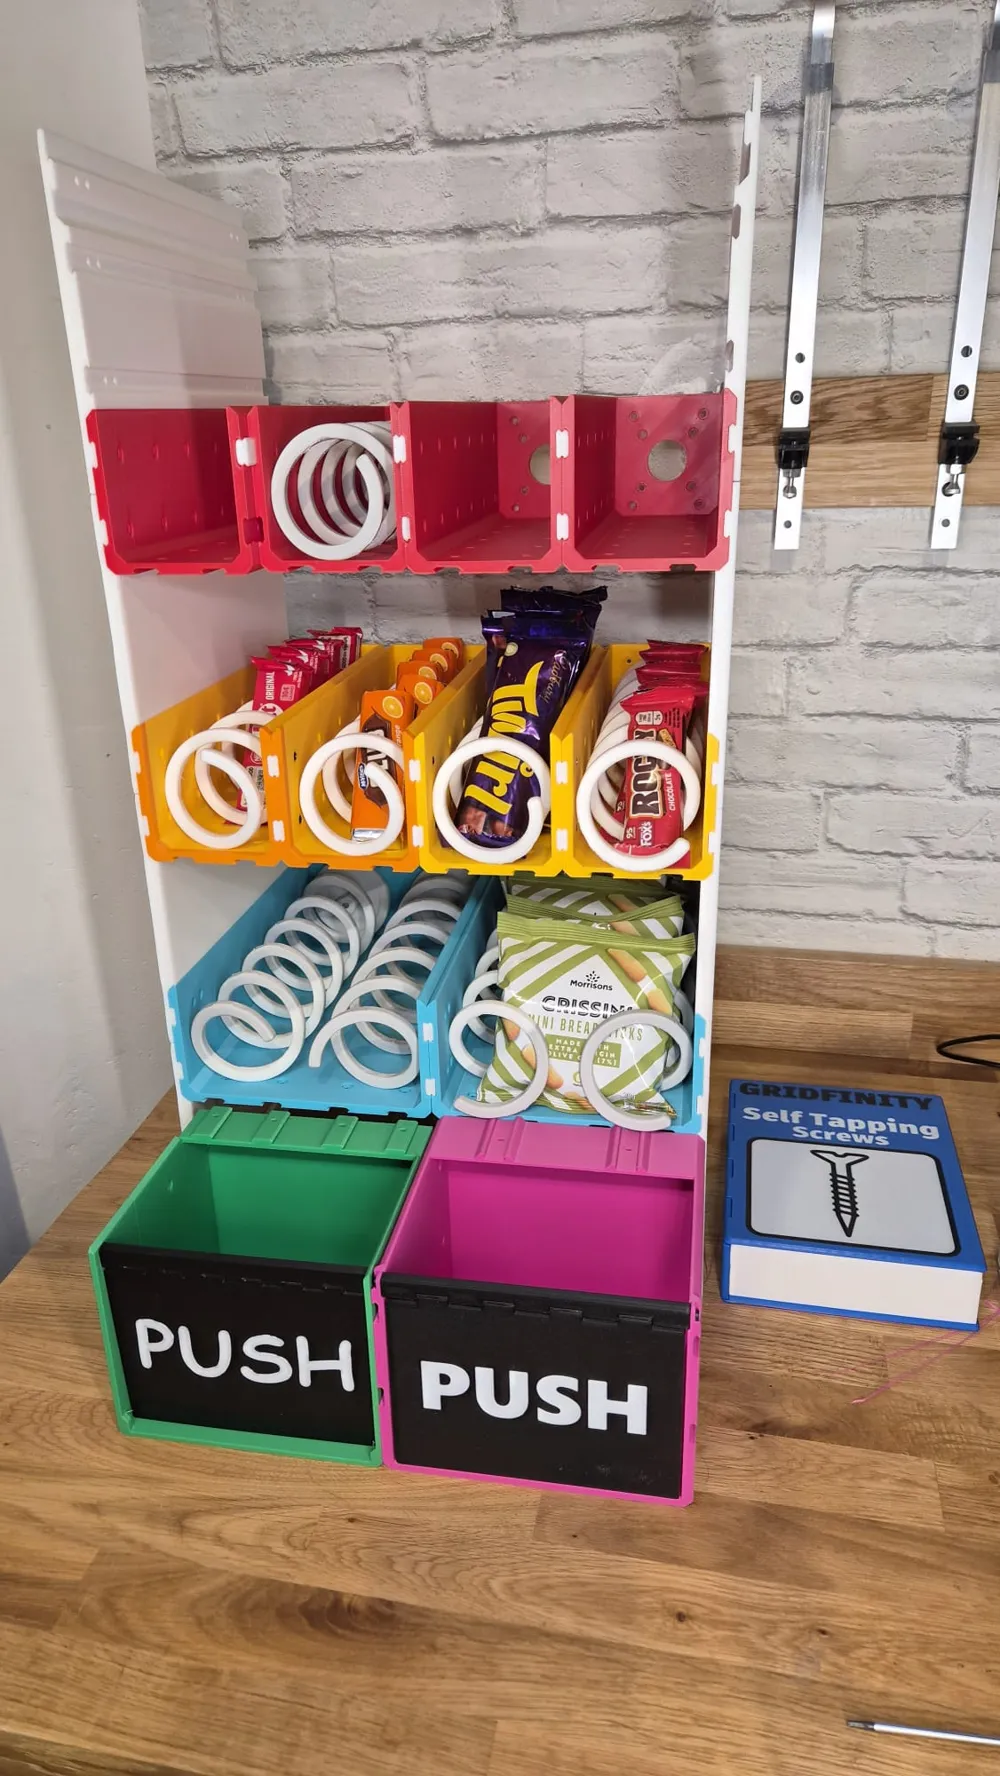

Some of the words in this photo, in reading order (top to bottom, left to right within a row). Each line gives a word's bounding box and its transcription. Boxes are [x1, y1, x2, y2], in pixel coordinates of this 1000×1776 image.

[265, 671, 276, 701] ORIGINAL
[540, 650, 567, 703] Cadbury
[464, 660, 544, 815] Twirl
[630, 729, 661, 816] ROCY
[664, 772, 676, 811] CHOCOLATE
[569, 979, 613, 991] Morrisons
[528, 1014, 554, 1029] INI
[548, 1044, 578, 1053] EXTRA
[556, 1039, 580, 1047] MADE
[739, 1082, 932, 1110] GRIDFINITY
[743, 1107, 803, 1124] Self
[808, 1112, 940, 1140] Tapping
[792, 1126, 890, 1146] Screws
[134, 1317, 356, 1393] PUSH
[420, 1360, 648, 1436] PUSH
